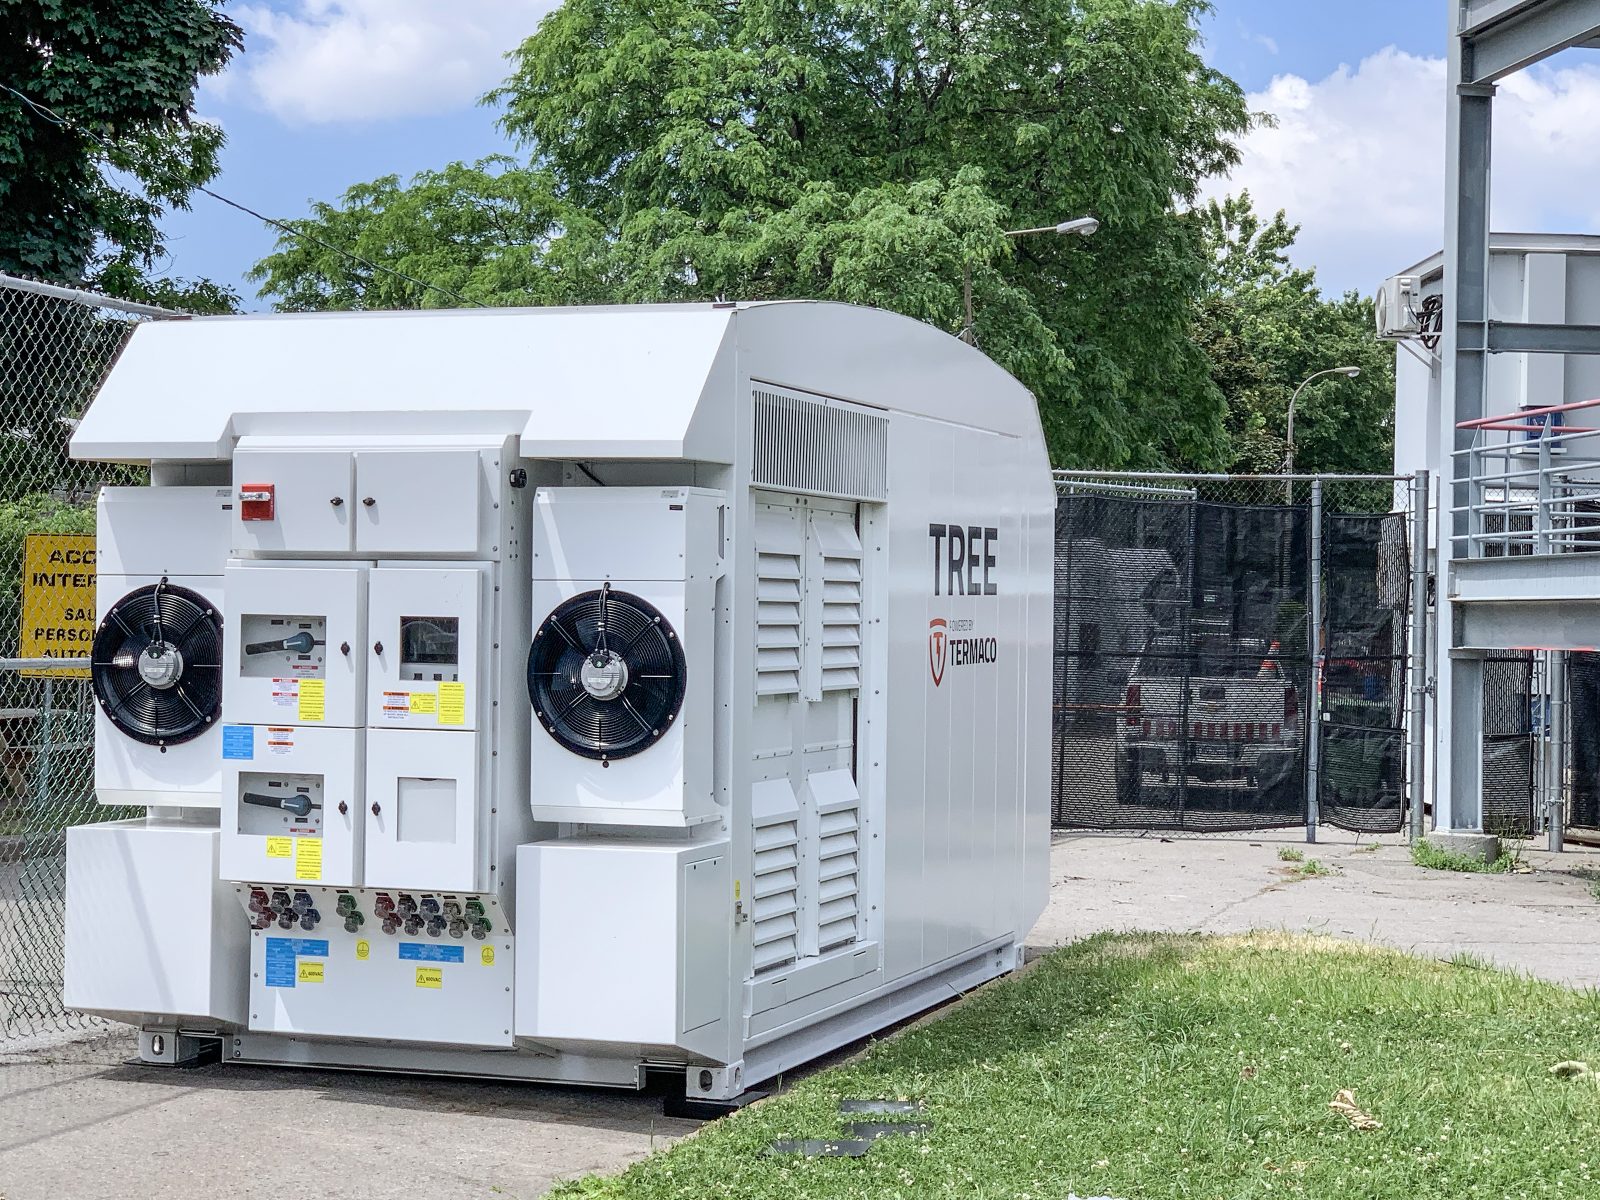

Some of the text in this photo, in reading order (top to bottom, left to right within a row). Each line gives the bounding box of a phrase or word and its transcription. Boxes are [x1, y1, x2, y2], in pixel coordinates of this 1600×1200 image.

[48, 550, 97, 564] ACC
[929, 523, 998, 596] TREE
[43, 648, 94, 658] AUTO
[949, 637, 997, 666] TERMACO
